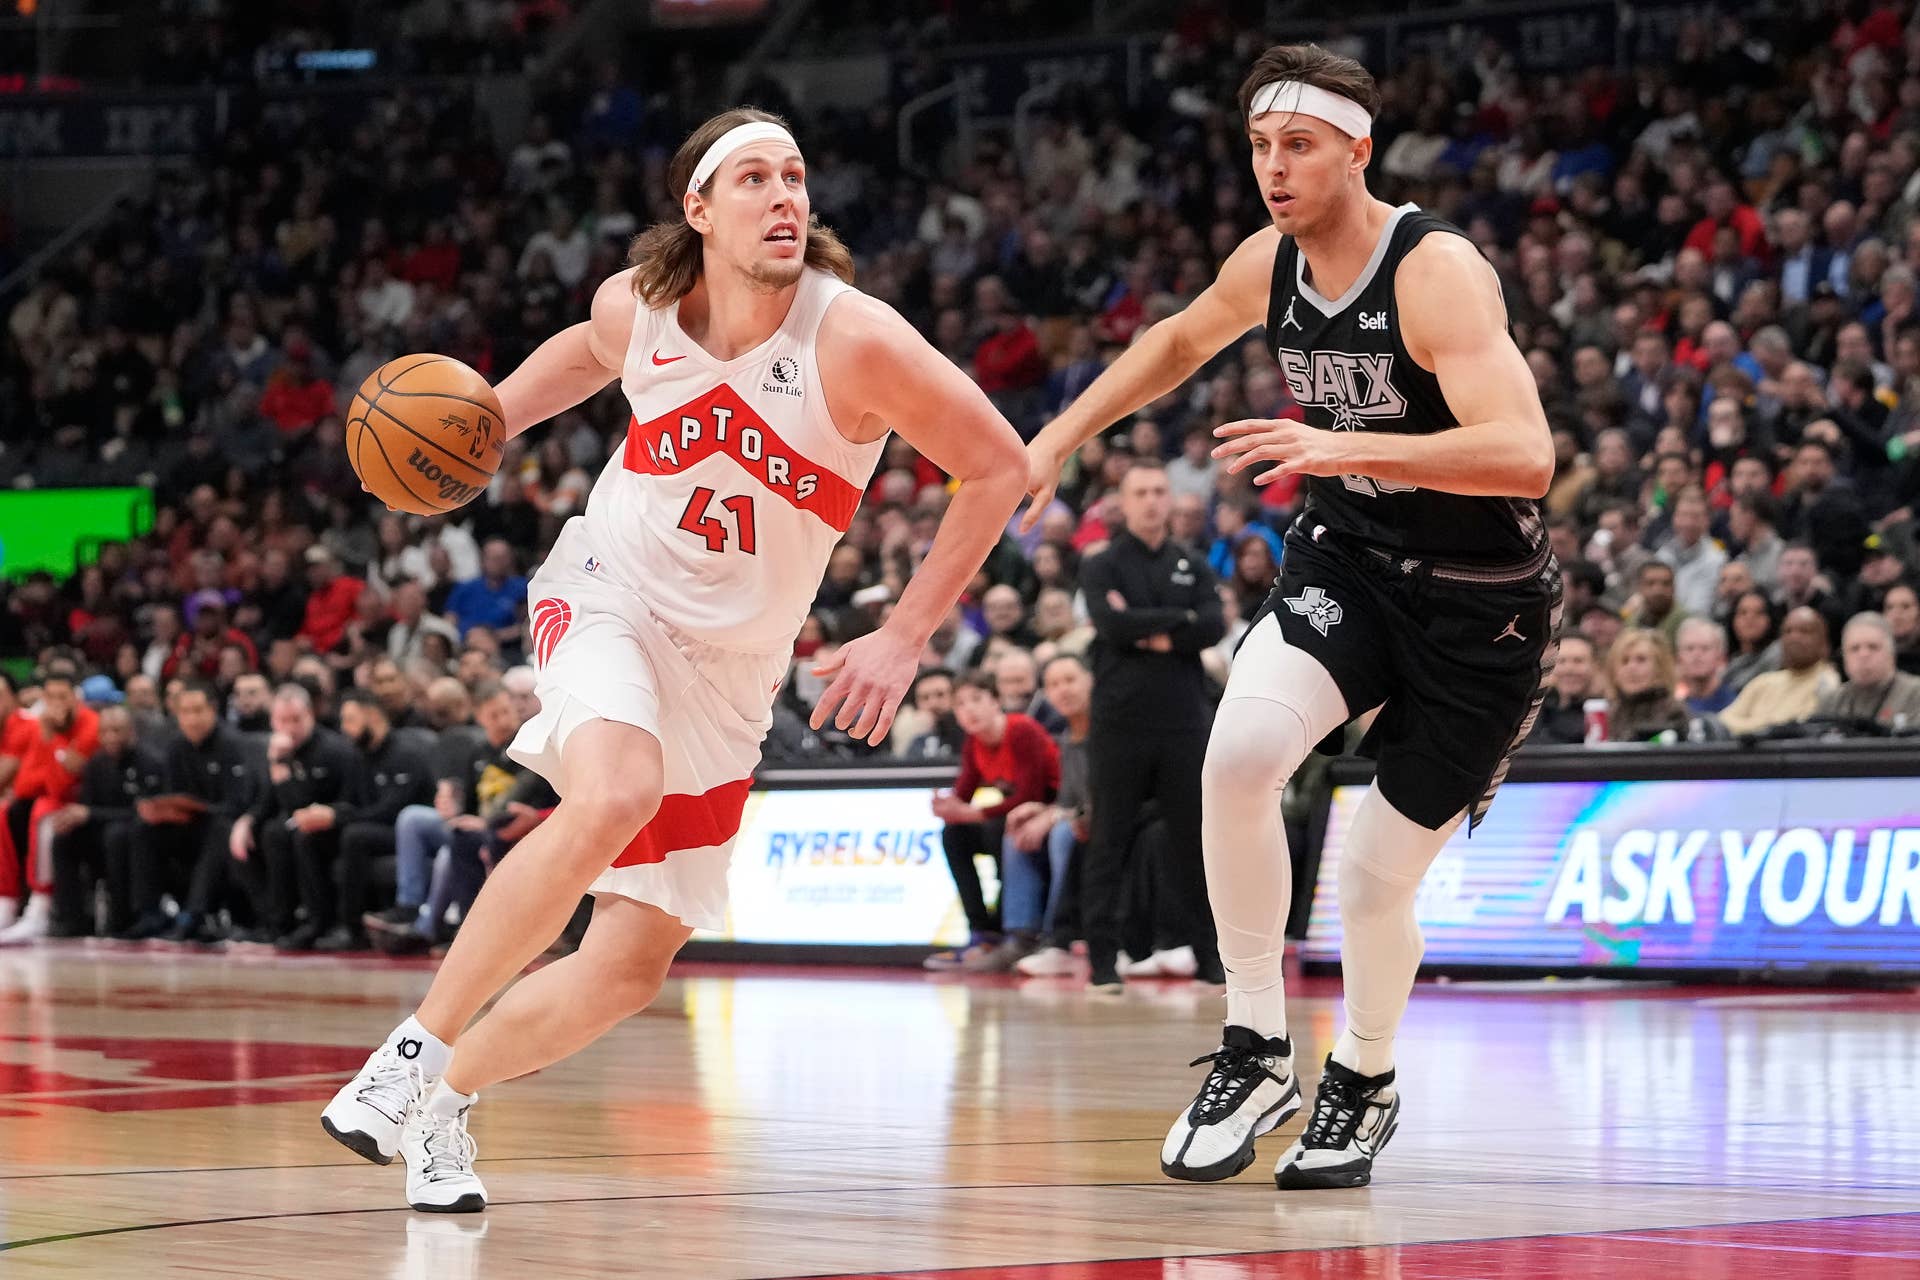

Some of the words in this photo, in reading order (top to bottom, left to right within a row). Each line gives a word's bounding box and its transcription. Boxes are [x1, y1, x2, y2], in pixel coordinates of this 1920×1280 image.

[762, 382, 783, 394] Sun
[785, 384, 803, 398] Life
[1278, 347, 1408, 420] SATX
[646, 406, 818, 500] APTORS
[677, 486, 756, 555] 41
[765, 831, 934, 867] RYBELSUS
[1544, 829, 1709, 925] ASK
